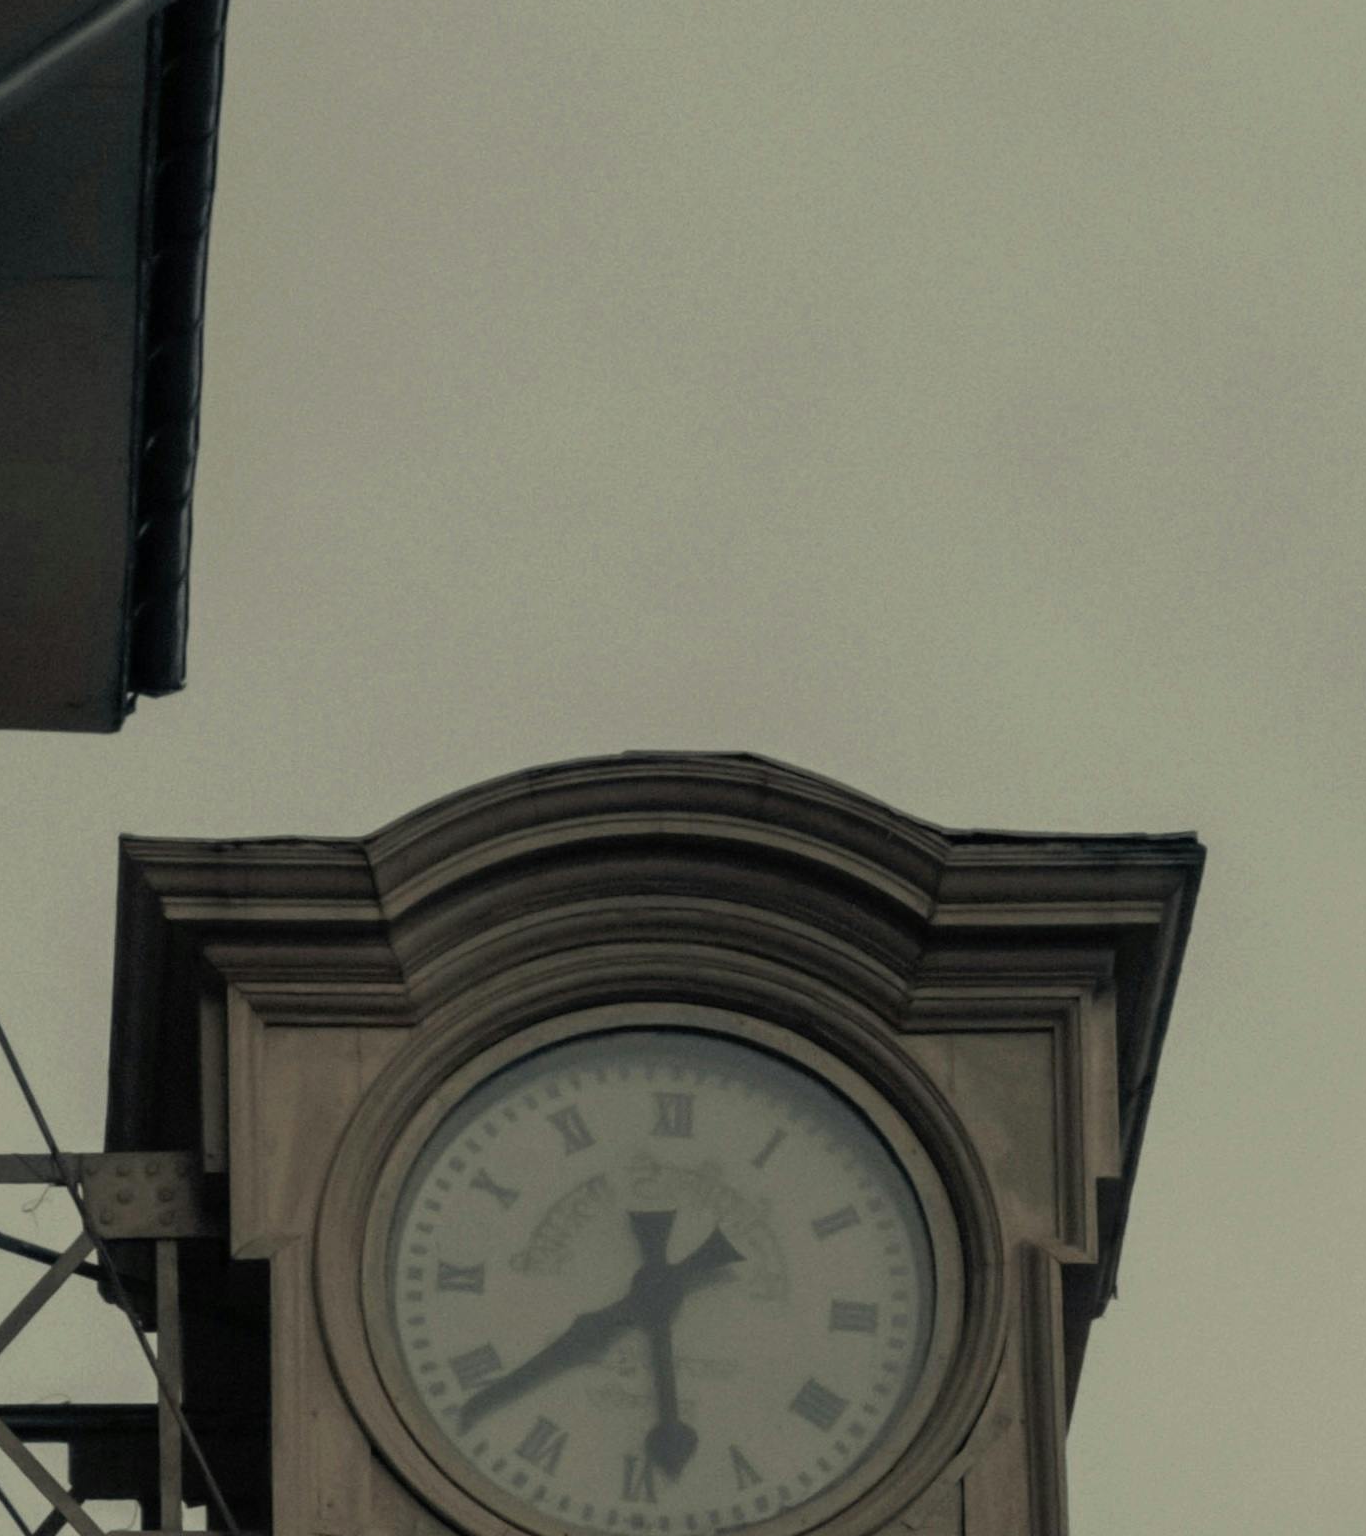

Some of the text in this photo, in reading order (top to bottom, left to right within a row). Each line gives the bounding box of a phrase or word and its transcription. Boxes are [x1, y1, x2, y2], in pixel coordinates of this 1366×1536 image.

[546, 1103, 597, 1157] XI
[649, 1092, 695, 1139] XII
[751, 1127, 788, 1169] I
[469, 1167, 520, 1210] X
[811, 1203, 861, 1243] II
[436, 1260, 485, 1295] IX
[828, 1299, 879, 1336] III
[513, 1415, 569, 1477] VII
[727, 1443, 763, 1491] V
[621, 1454, 657, 1504] VI
